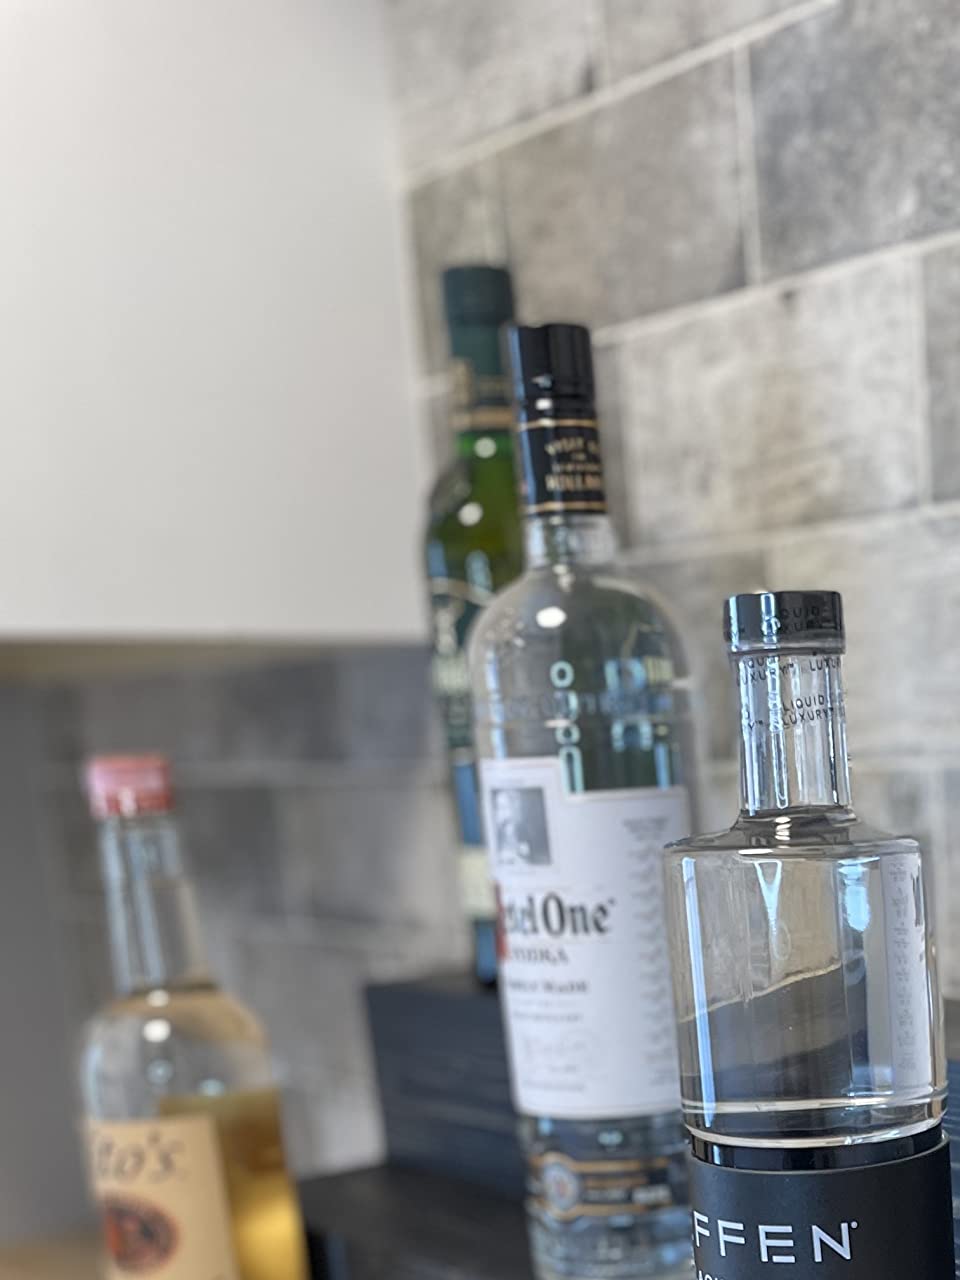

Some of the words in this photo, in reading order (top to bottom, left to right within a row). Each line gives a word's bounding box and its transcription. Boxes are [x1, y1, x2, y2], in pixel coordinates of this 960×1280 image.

[783, 695, 826, 712] LIQUID
[541, 891, 610, 938] One
[693, 1210, 852, 1263] FFEN
